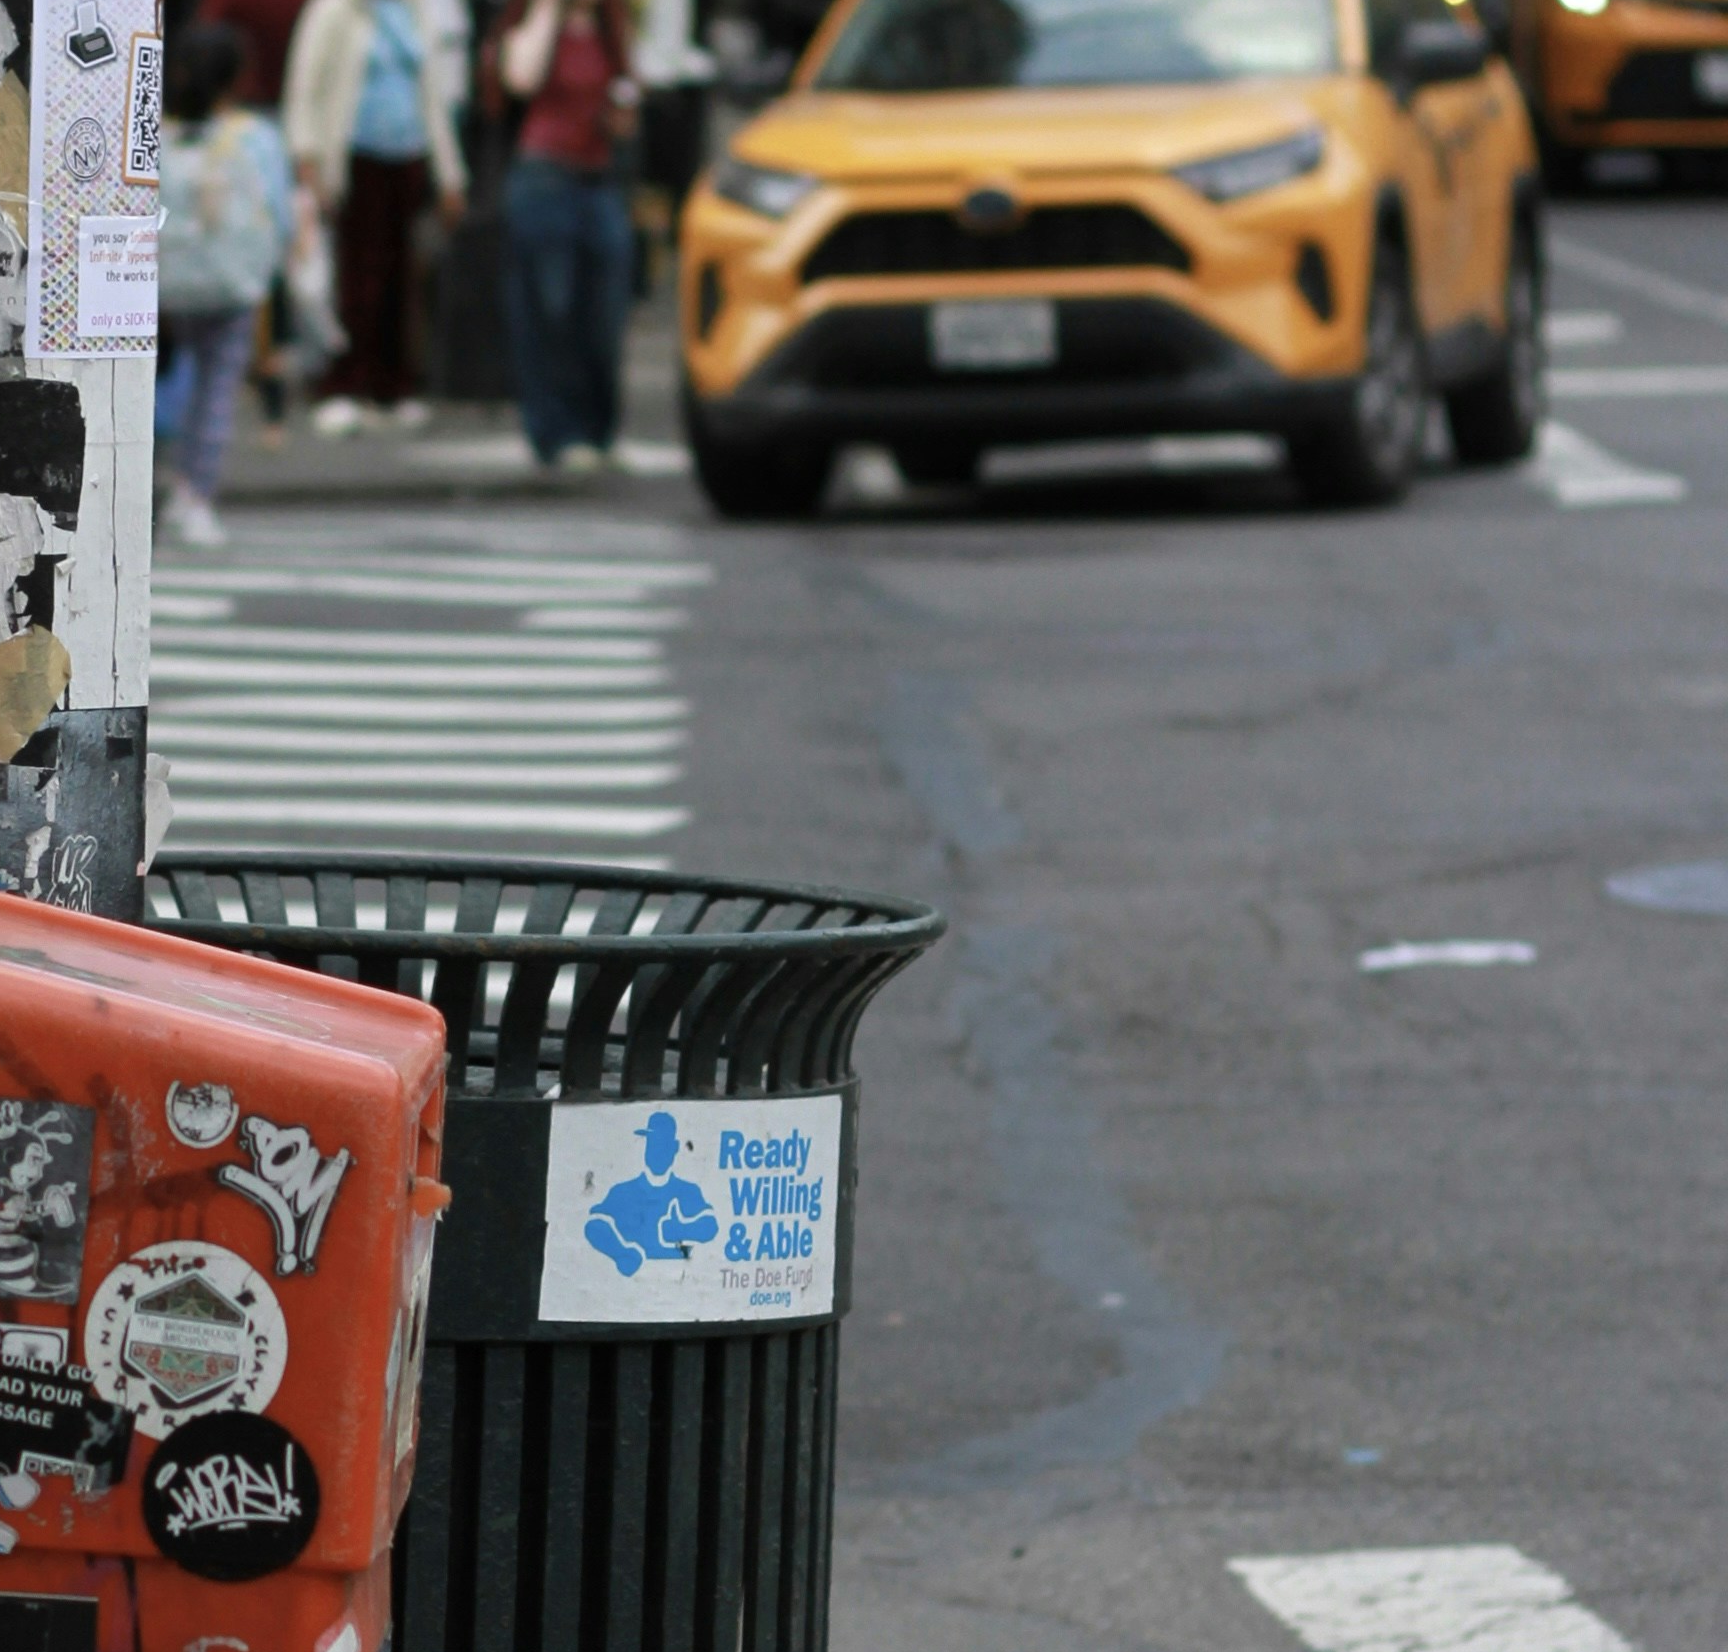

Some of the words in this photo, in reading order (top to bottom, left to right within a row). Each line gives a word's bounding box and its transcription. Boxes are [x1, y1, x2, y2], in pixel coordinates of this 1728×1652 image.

[73, 143, 102, 170] NY
[93, 233, 111, 247] you
[113, 233, 129, 245] say
[106, 270, 121, 282] the
[123, 270, 148, 282] works
[91, 314, 113, 329] only
[115, 316, 122, 326] a
[719, 1128, 812, 1176] Ready
[729, 1175, 823, 1222] Willing
[755, 1220, 813, 1261] Able
[720, 1269, 749, 1289] The
[755, 1267, 782, 1288] Doe
[785, 1265, 813, 1289] Fund
[749, 1290, 792, 1309] doe.org
[29, 1381, 84, 1408] YOUR
